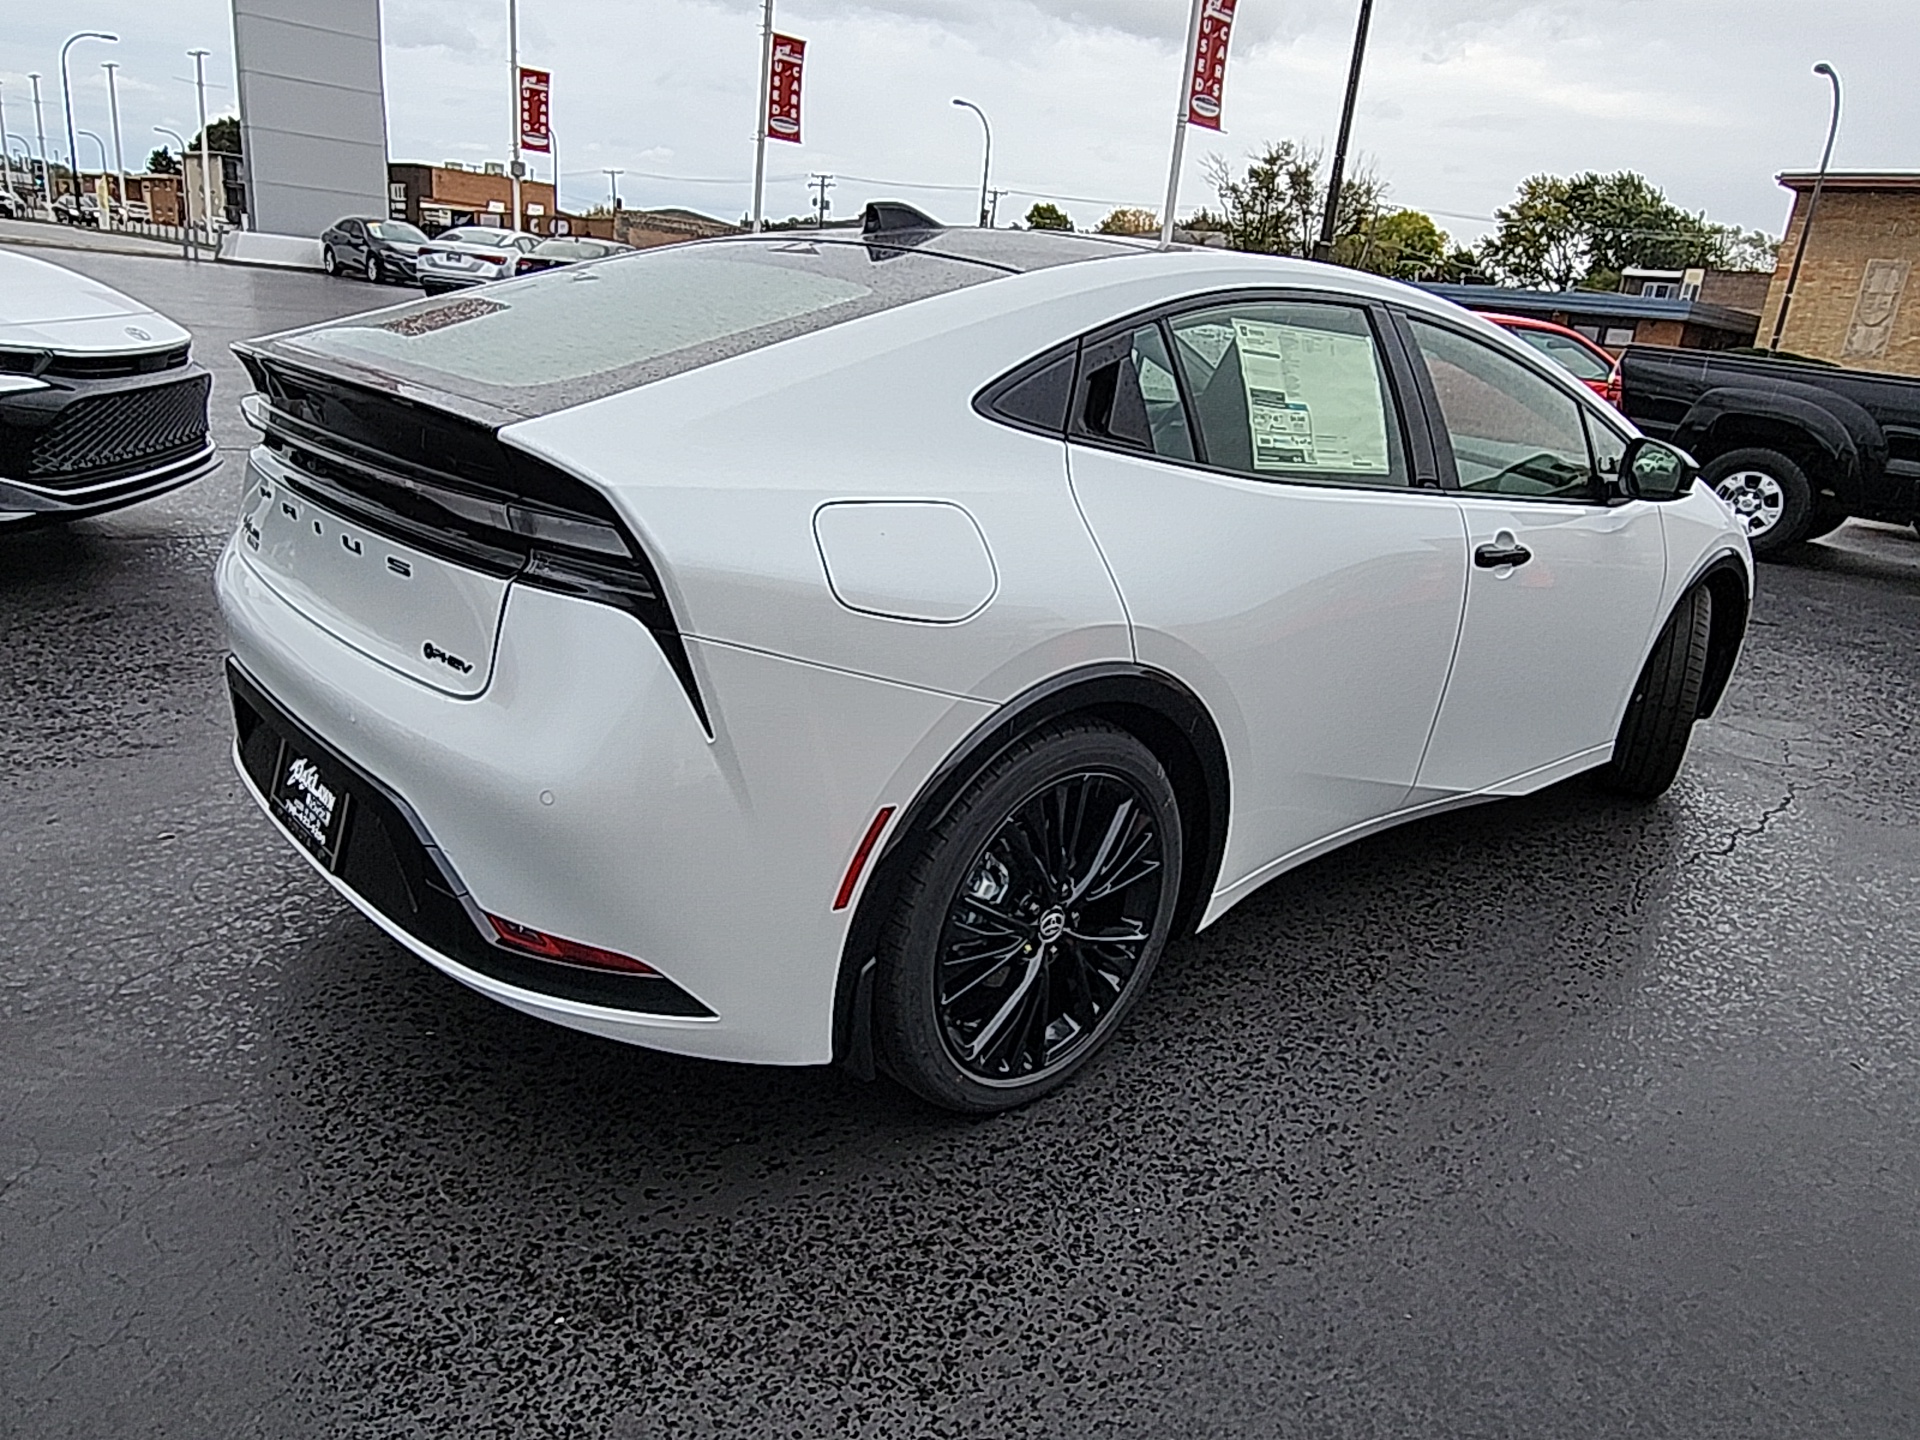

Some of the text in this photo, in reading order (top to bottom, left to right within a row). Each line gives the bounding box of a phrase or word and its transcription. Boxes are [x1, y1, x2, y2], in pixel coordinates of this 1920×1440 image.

[771, 60, 783, 114] USED
[1194, 19, 1212, 92] USED
[1211, 26, 1229, 98] CARS
[790, 66, 801, 119] CARS
[259, 485, 412, 578] PRIUS
